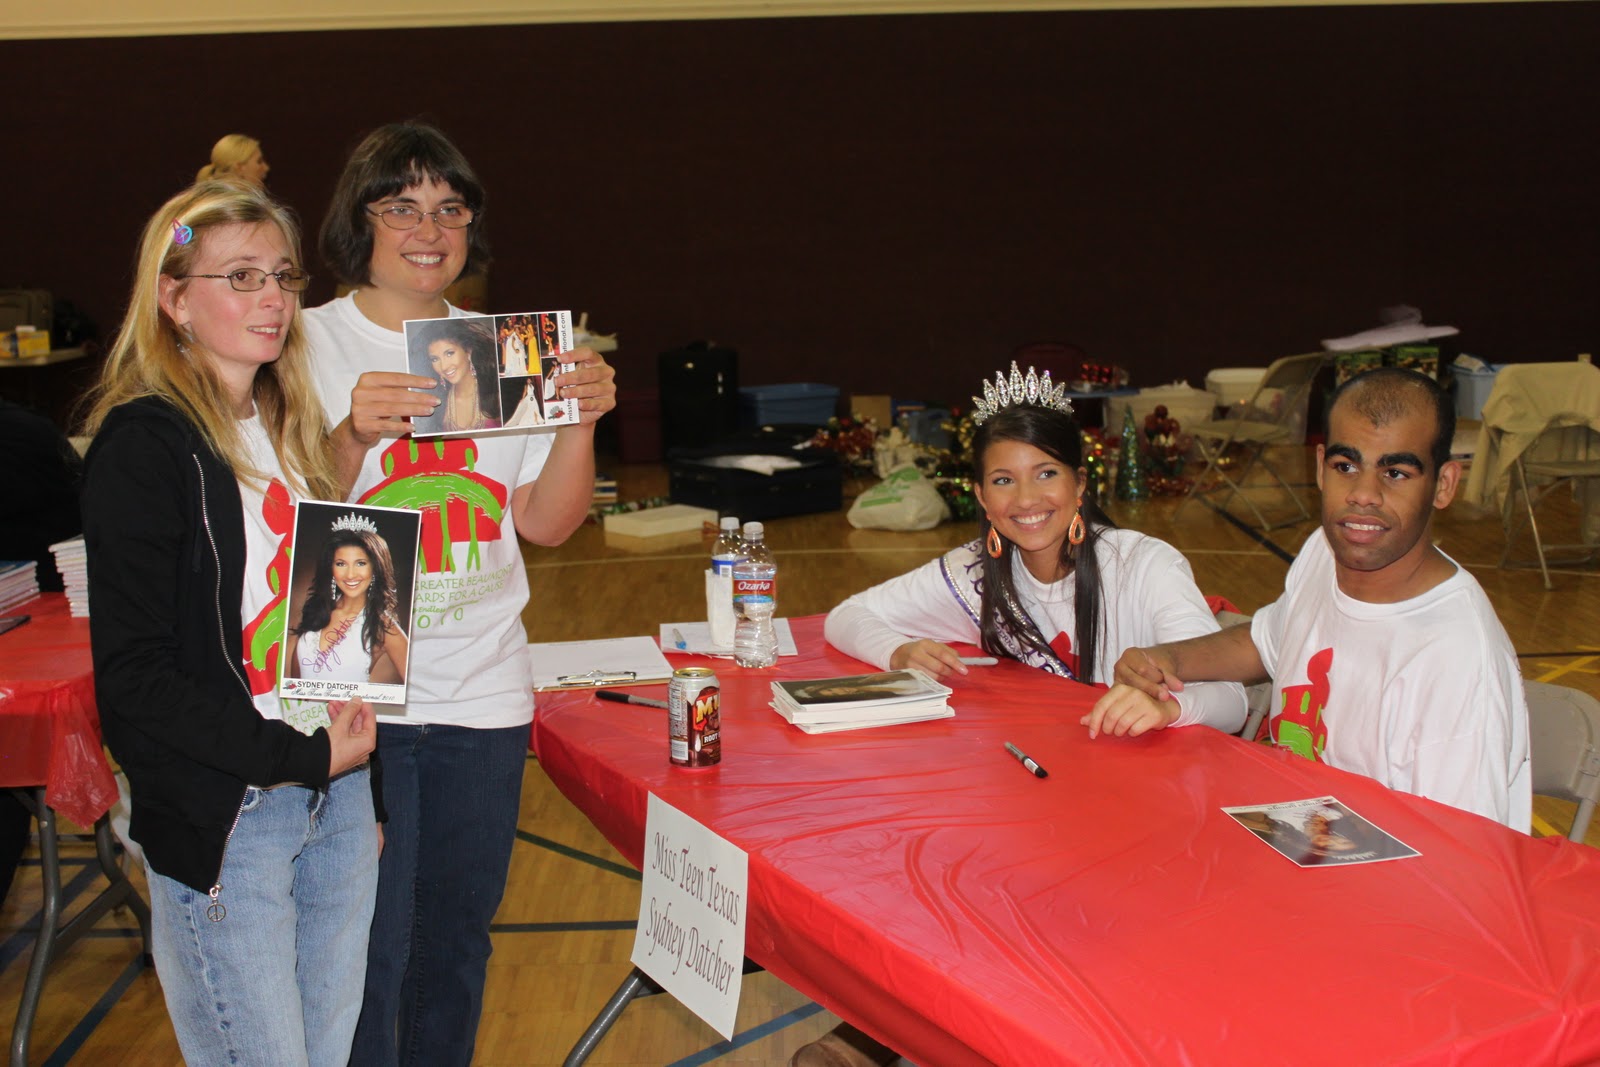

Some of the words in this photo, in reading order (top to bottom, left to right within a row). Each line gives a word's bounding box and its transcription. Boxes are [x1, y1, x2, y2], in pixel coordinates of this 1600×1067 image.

[466, 563, 513, 585] BEAUMONT
[415, 591, 445, 603] ARDS
[448, 590, 467, 602] FOR
[468, 588, 476, 597] A
[478, 580, 505, 595] CAUSE
[738, 581, 770, 591] Ozarka
[291, 689, 306, 697] Miss
[310, 689, 323, 698] Teen
[324, 690, 341, 698] Texas
[297, 681, 326, 690] SYDNEY
[326, 683, 359, 691] DATCHER
[704, 732, 718, 744] ROOT
[652, 831, 678, 883] Miss
[679, 844, 705, 903] Teen
[706, 863, 740, 926] Texas
[646, 896, 687, 976] Sydney
[685, 926, 735, 996] Datcher
